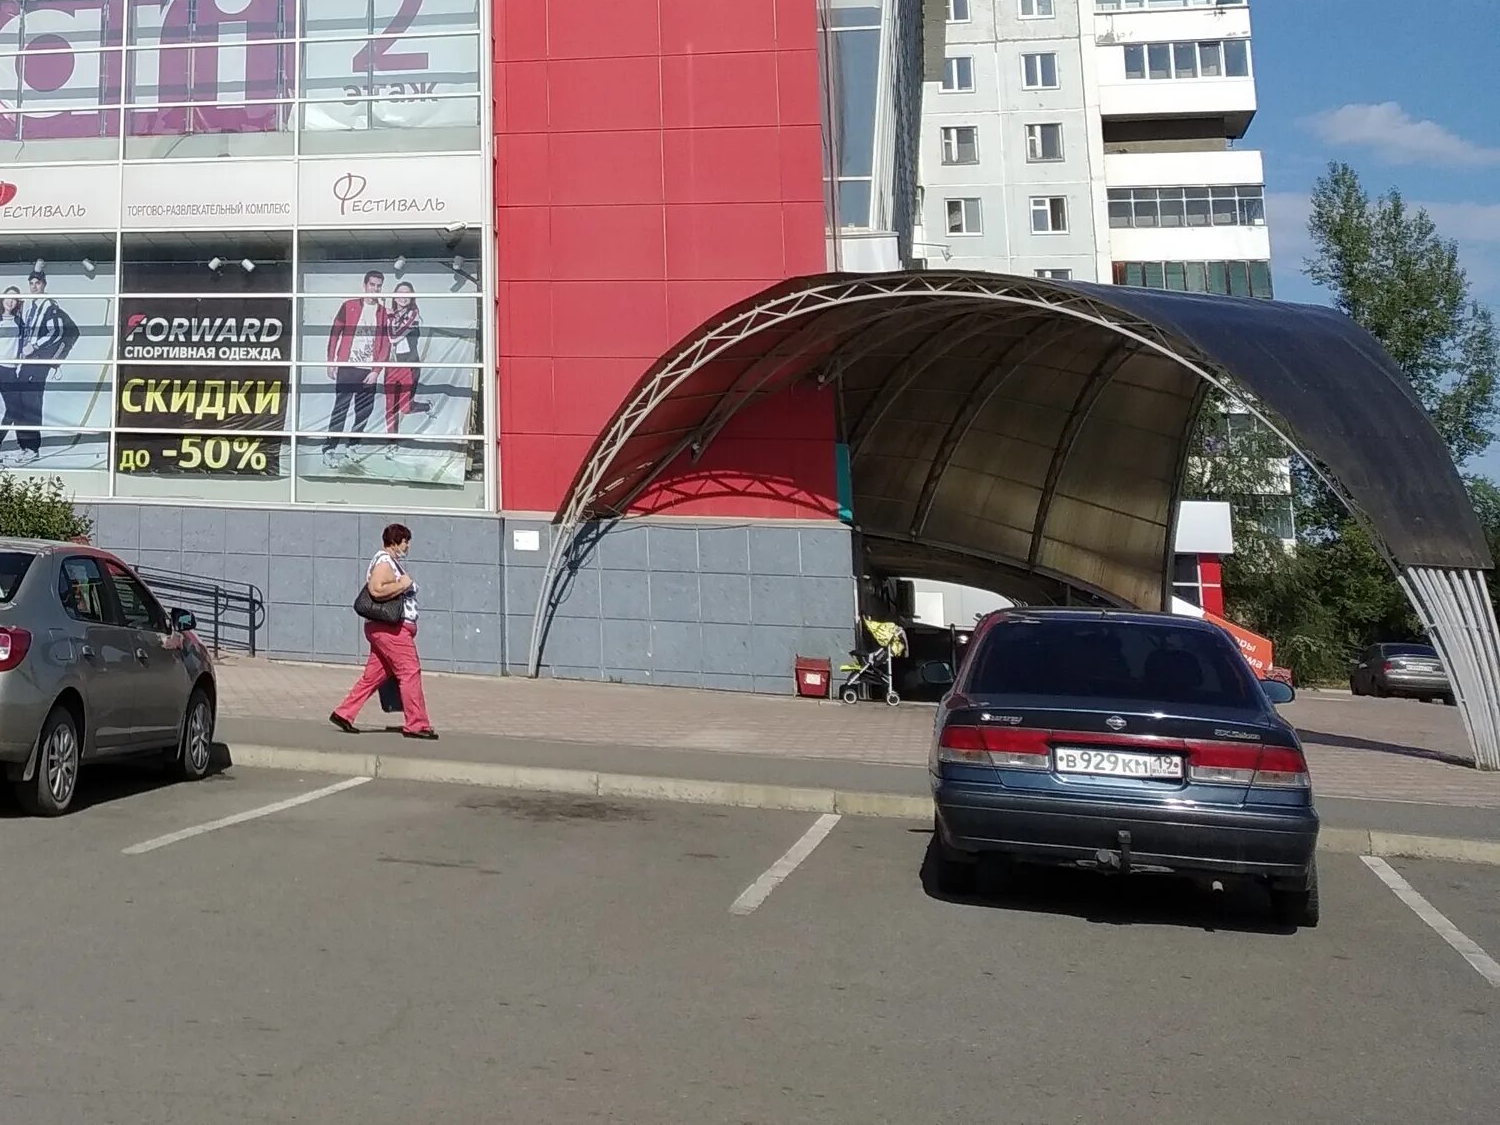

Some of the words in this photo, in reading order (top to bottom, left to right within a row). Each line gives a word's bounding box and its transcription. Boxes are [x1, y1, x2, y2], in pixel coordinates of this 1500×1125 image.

[245, 203, 290, 215] КОМПЛЕКС
[123, 314, 283, 342] FORWARD
[124, 346, 216, 359] СПОРТИВНАЯ
[218, 347, 282, 361] ОДЕЖДА
[121, 378, 282, 420] СКИДКИ
[162, 436, 267, 470] -50%
